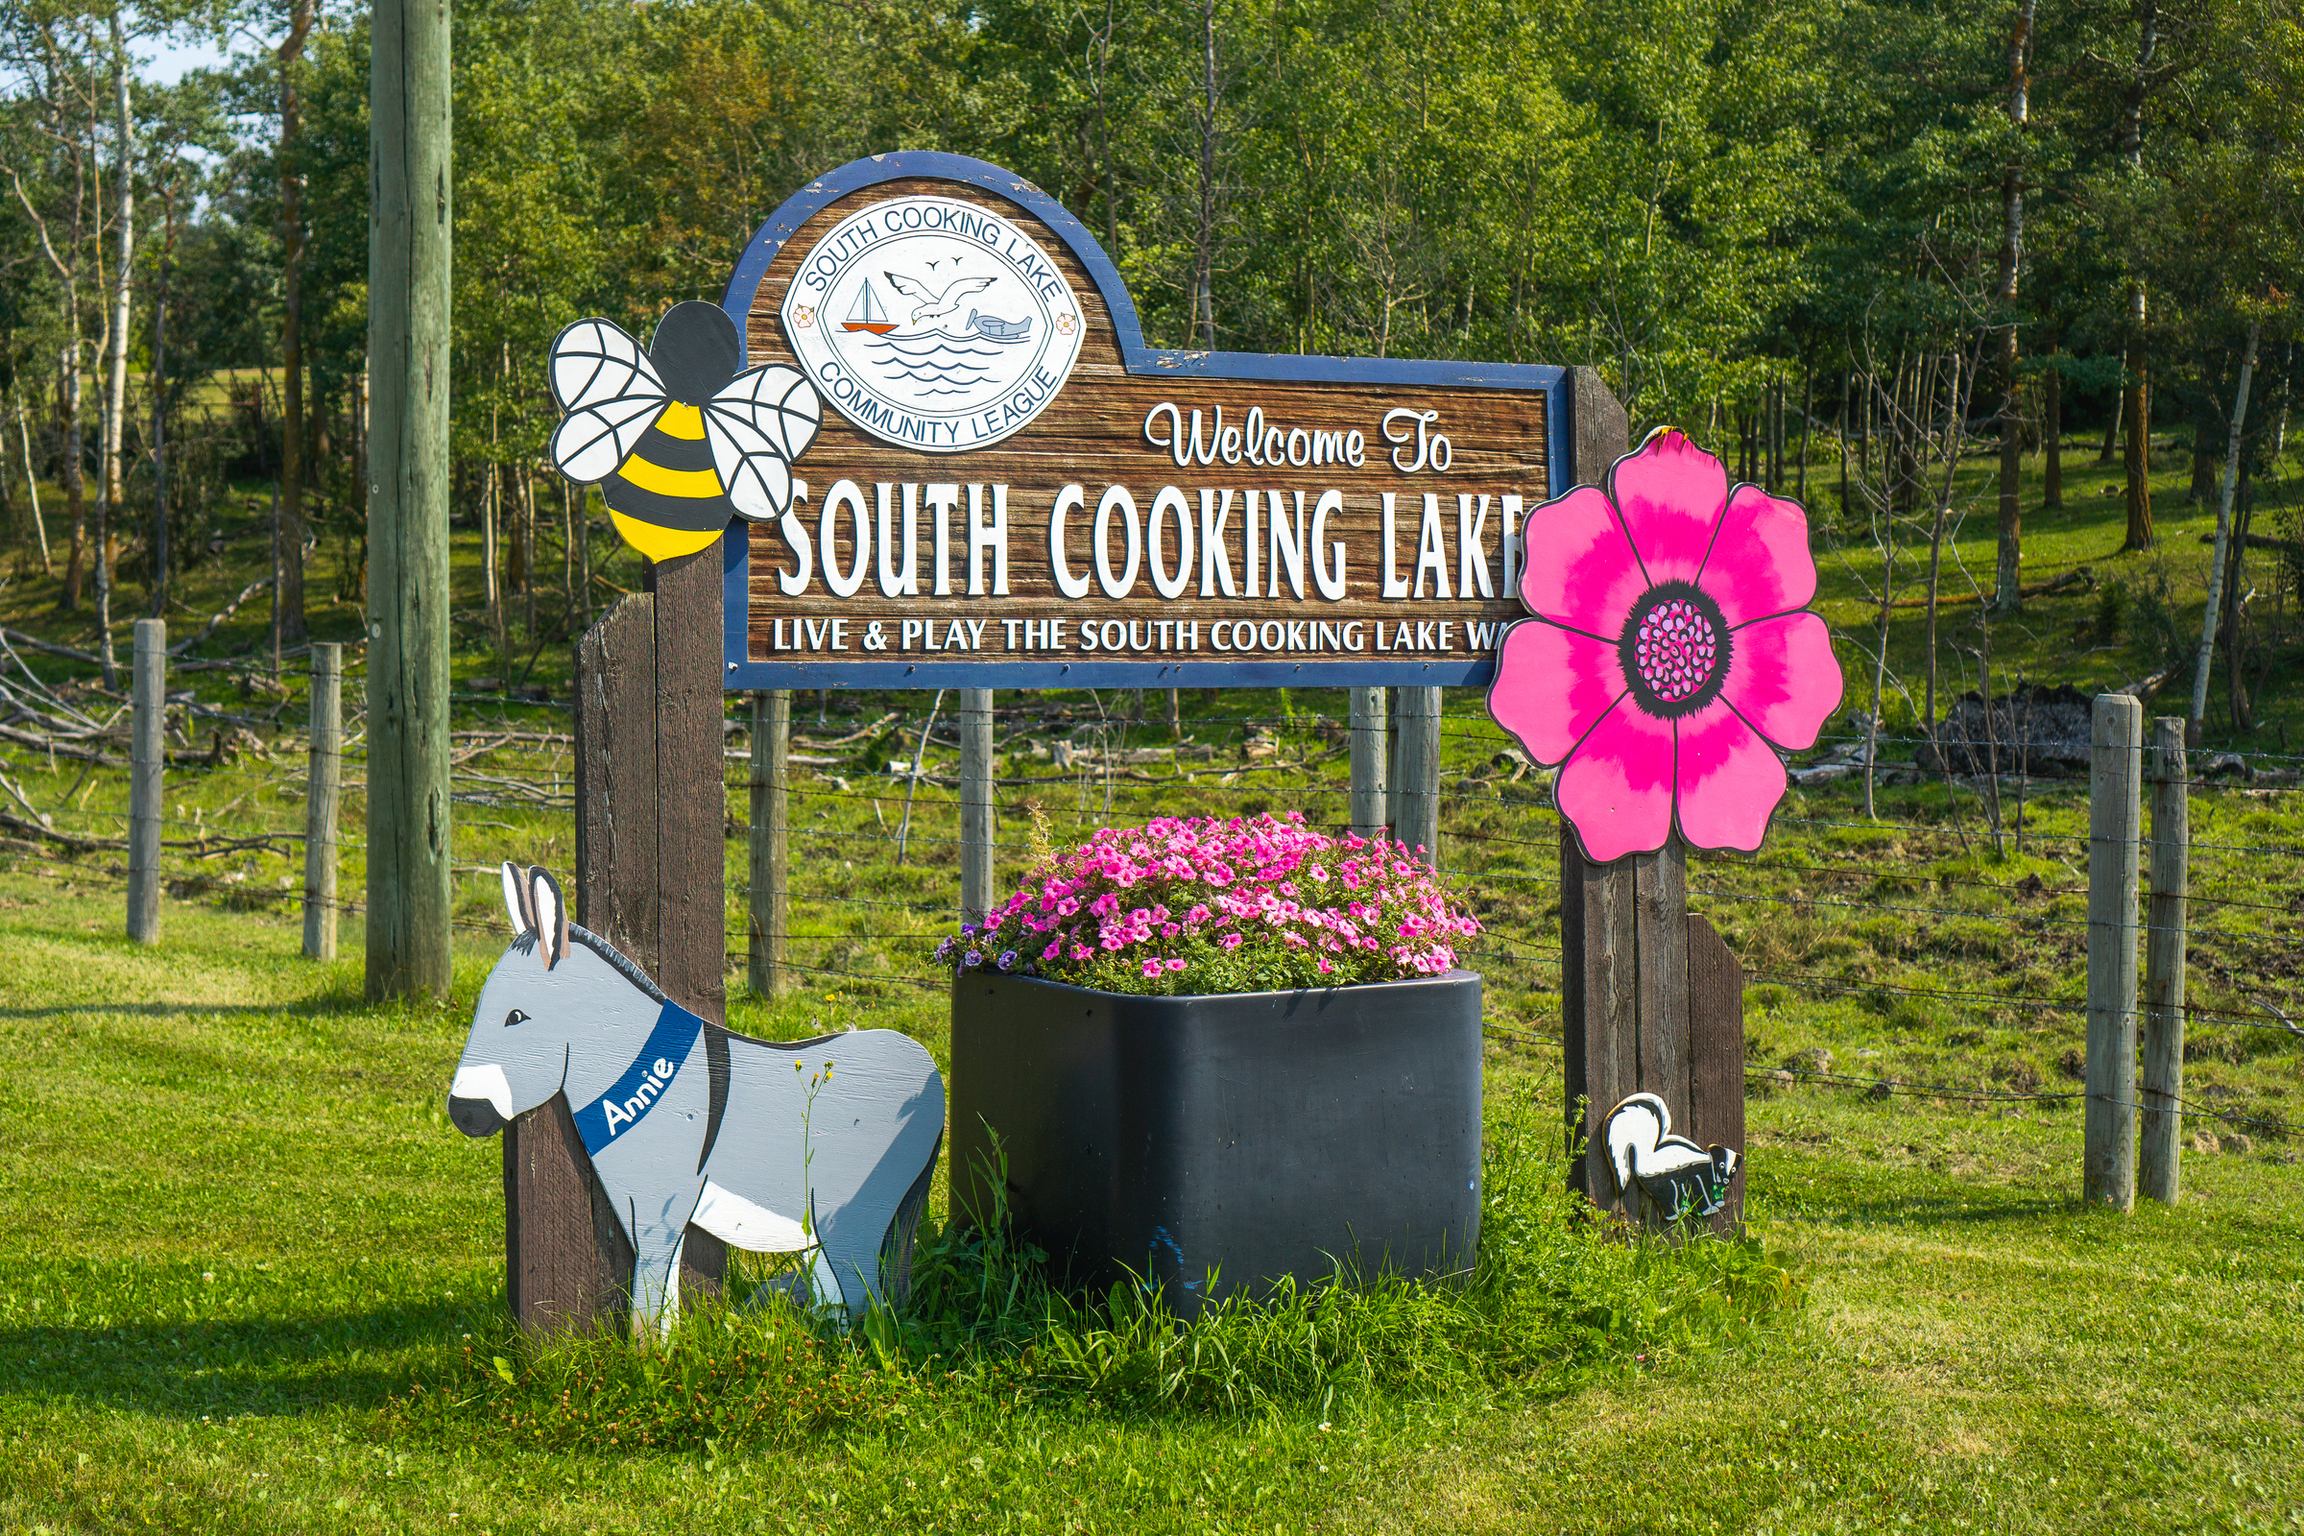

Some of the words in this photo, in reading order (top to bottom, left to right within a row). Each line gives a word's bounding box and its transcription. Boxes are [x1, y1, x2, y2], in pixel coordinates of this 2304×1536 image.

[806, 220, 879, 292] SOUTH
[884, 206, 1000, 247] COOKING
[1006, 241, 1063, 303] LAKE
[819, 361, 960, 444] COMMUNITY
[972, 364, 1057, 439] LEAGUE
[1144, 402, 1366, 468] Welcome
[1382, 408, 1453, 473] To
[778, 478, 1010, 598] SOUTH
[1050, 484, 1347, 600] COOKING
[774, 619, 849, 651] LIVE
[863, 620, 888, 651] &
[902, 619, 987, 651] PLAY
[1001, 619, 1067, 651] THE
[1080, 619, 1199, 651] SOUTH
[1210, 620, 1364, 652] COOKING
[1375, 621, 1453, 651] LAKE
[602, 1057, 674, 1137] Annie
